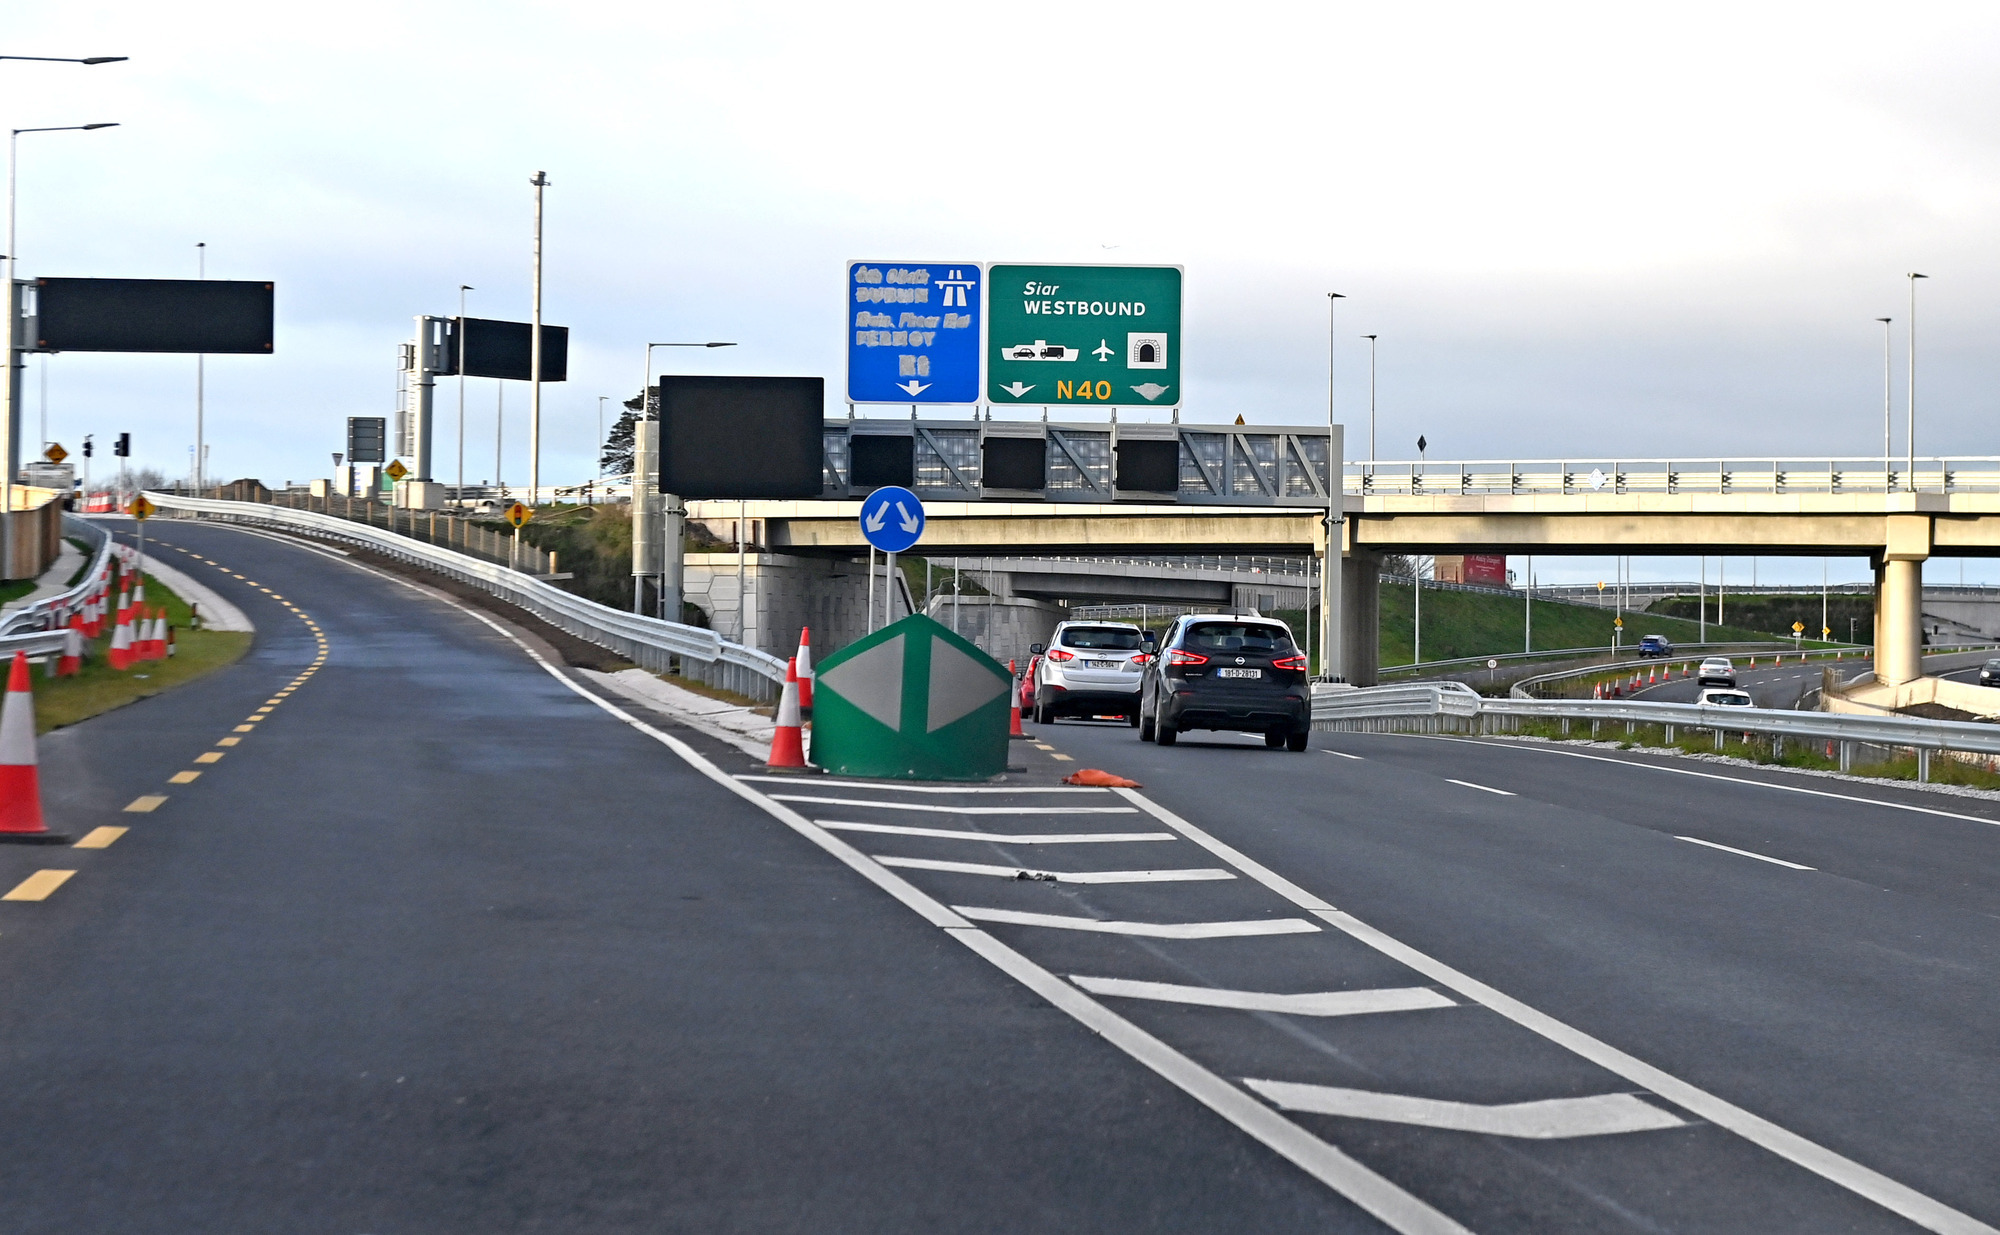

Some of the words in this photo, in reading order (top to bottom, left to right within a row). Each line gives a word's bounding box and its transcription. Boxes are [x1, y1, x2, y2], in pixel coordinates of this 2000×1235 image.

[1023, 281, 1060, 296] Siar
[1024, 300, 1146, 316] WESTBOUND
[1057, 380, 1112, 400] N40
